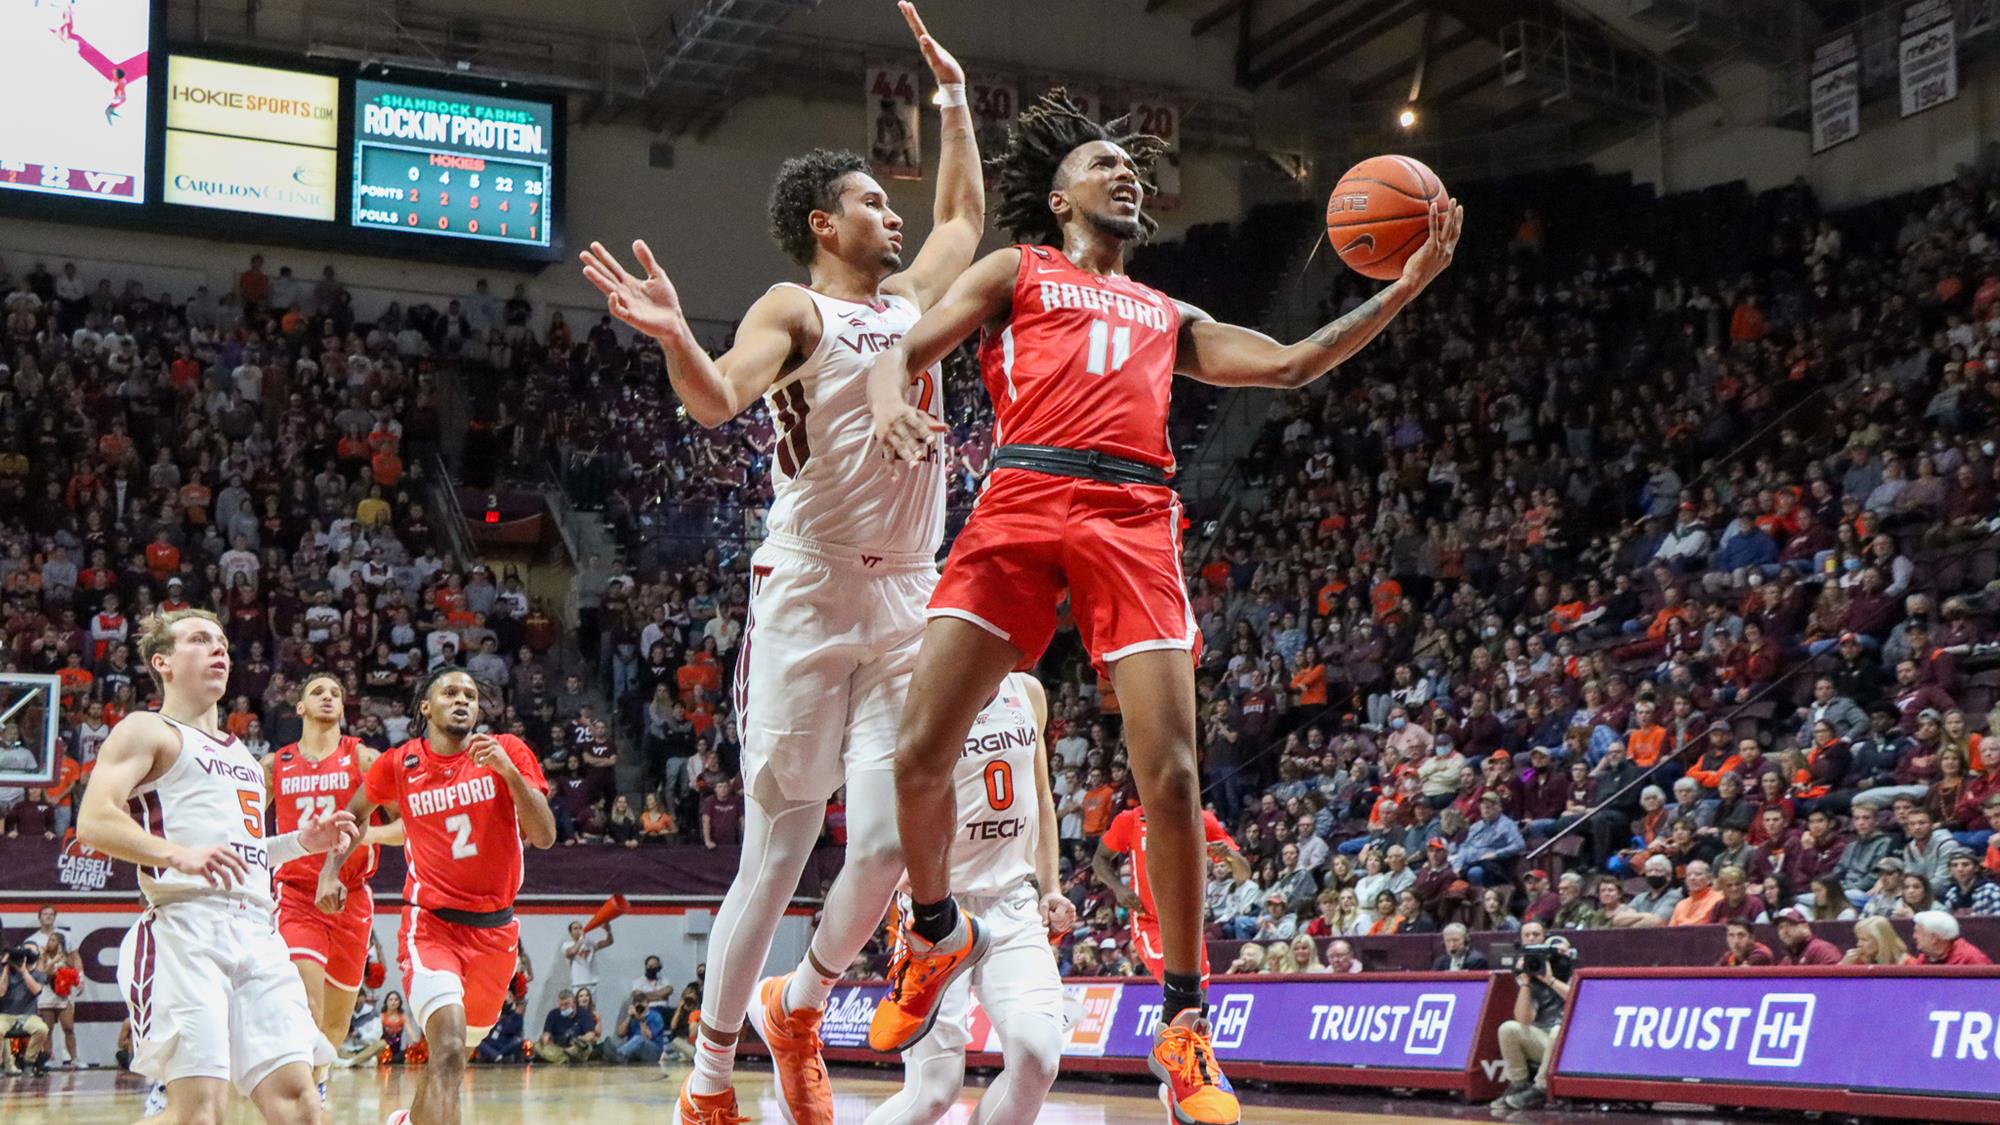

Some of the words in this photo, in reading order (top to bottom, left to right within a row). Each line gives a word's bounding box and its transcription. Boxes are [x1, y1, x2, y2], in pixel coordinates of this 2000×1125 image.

[872, 70, 914, 105] 44
[974, 85, 1011, 120] 30
[381, 94, 471, 116] SHAMROCK
[475, 105, 528, 123] FARMS
[1137, 104, 1172, 138] 20
[451, 115, 542, 154] PROTEIN
[429, 154, 486, 171] HOKIES
[408, 166, 420, 181] 0
[439, 171, 450, 184] 4
[469, 174, 480, 188] 5
[495, 177, 513, 193] 22
[524, 180, 543, 195] 25
[360, 185, 404, 200] POINTS
[409, 189, 419, 202] 2
[439, 192, 449, 205] 2
[469, 196, 479, 209] 5
[499, 201, 509, 212] 4
[529, 202, 538, 215] 7
[359, 209, 399, 223] FOULS
[408, 213, 418, 226] 0
[438, 216, 448, 229] 0
[468, 219, 479, 233] 0
[500, 223, 507, 235] 1
[529, 226, 536, 239] 1
[1039, 280, 1168, 333] RADFORD
[1086, 318, 1131, 376] 11
[488, 494, 497, 508] 3
[959, 727, 1036, 758] RGINIA
[280, 771, 349, 796] RADFORD
[407, 775, 496, 817] RADFORD
[984, 759, 1015, 811] 0
[236, 788, 263, 839] 5
[445, 813, 478, 860] 2
[57, 853, 114, 876] CASSELL
[60, 868, 107, 889] GUARD
[1308, 1004, 1411, 1042] TRUIST
[1612, 1005, 1752, 1051] TRUIST
